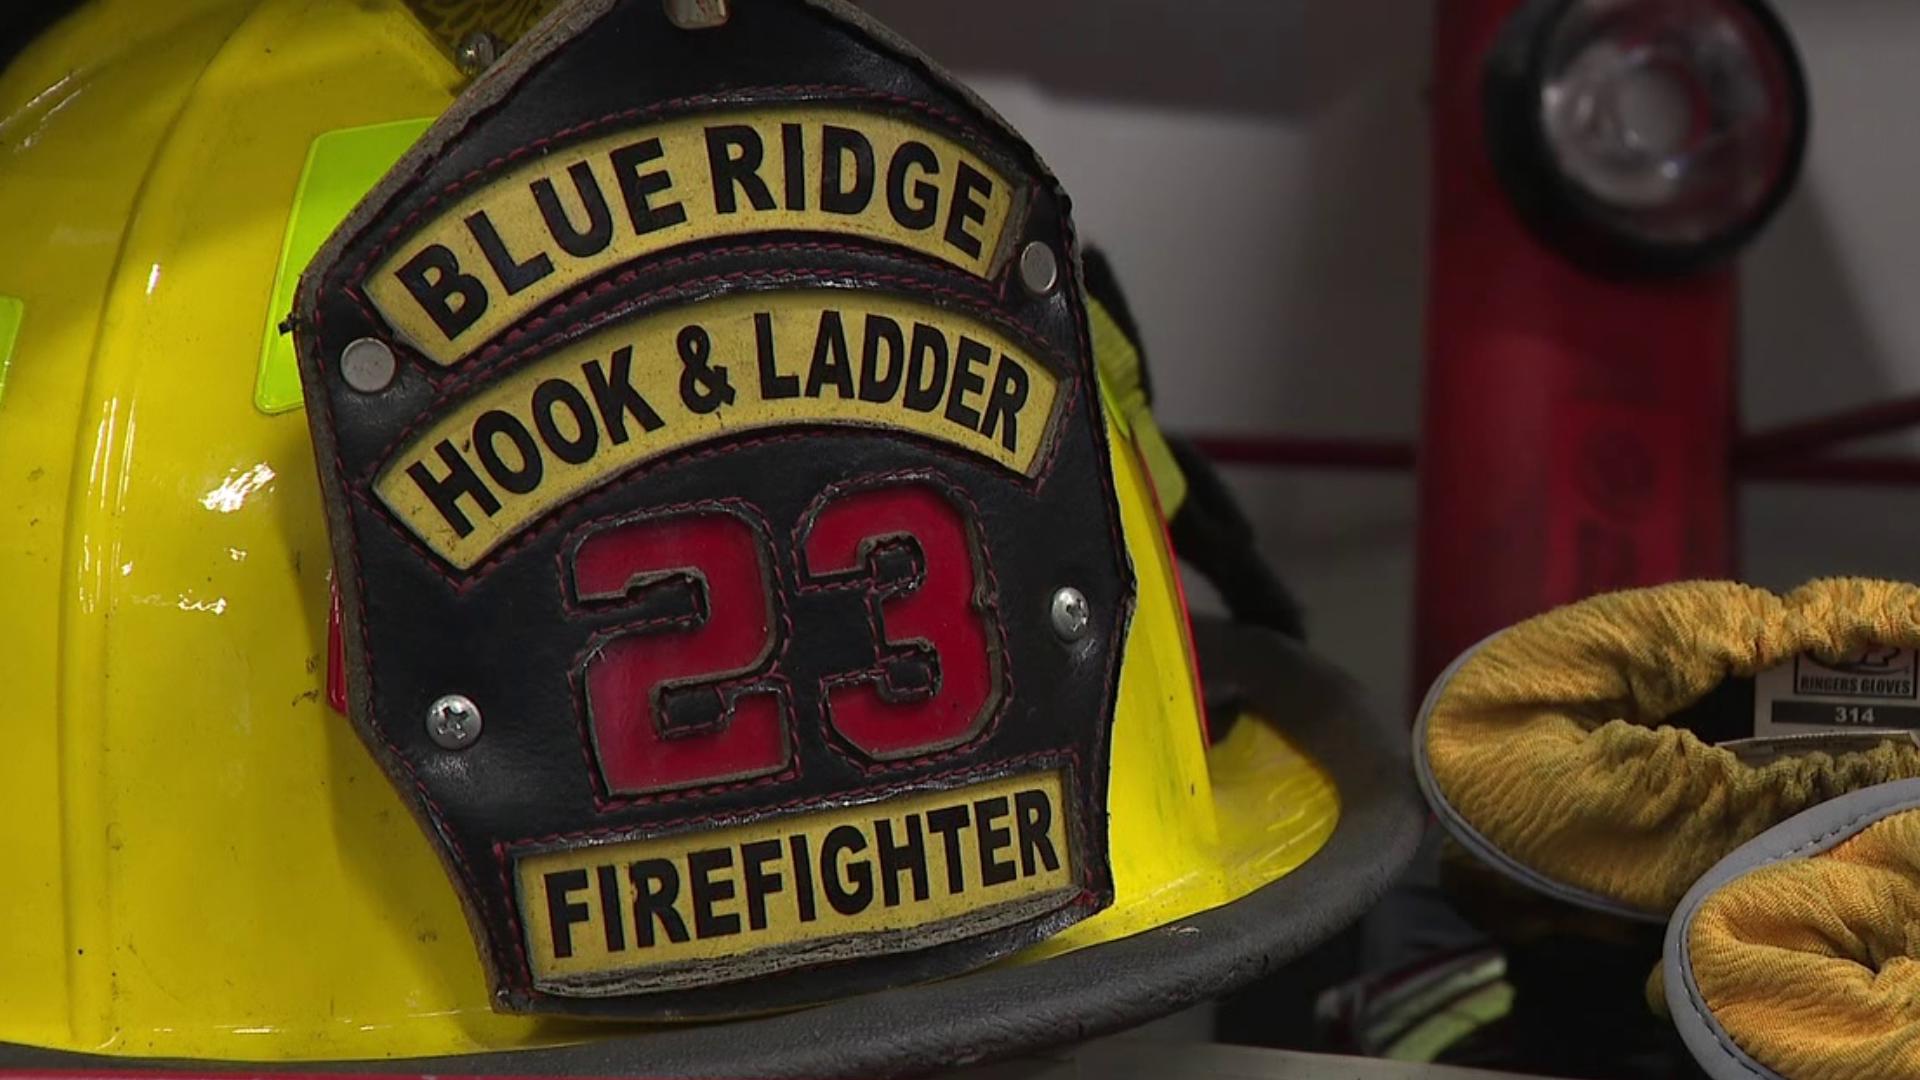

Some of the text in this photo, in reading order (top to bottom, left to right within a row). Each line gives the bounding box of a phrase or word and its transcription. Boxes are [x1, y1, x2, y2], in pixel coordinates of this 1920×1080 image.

[394, 123, 993, 341] BLUE RIDGE
[406, 311, 1030, 539] HOOK & LADDER
[573, 483, 1001, 796] 23
[1801, 676, 1911, 694] RINGERS GLOVES
[1835, 706, 1875, 723] 314
[543, 788, 1061, 958] FIREFIGHTER
